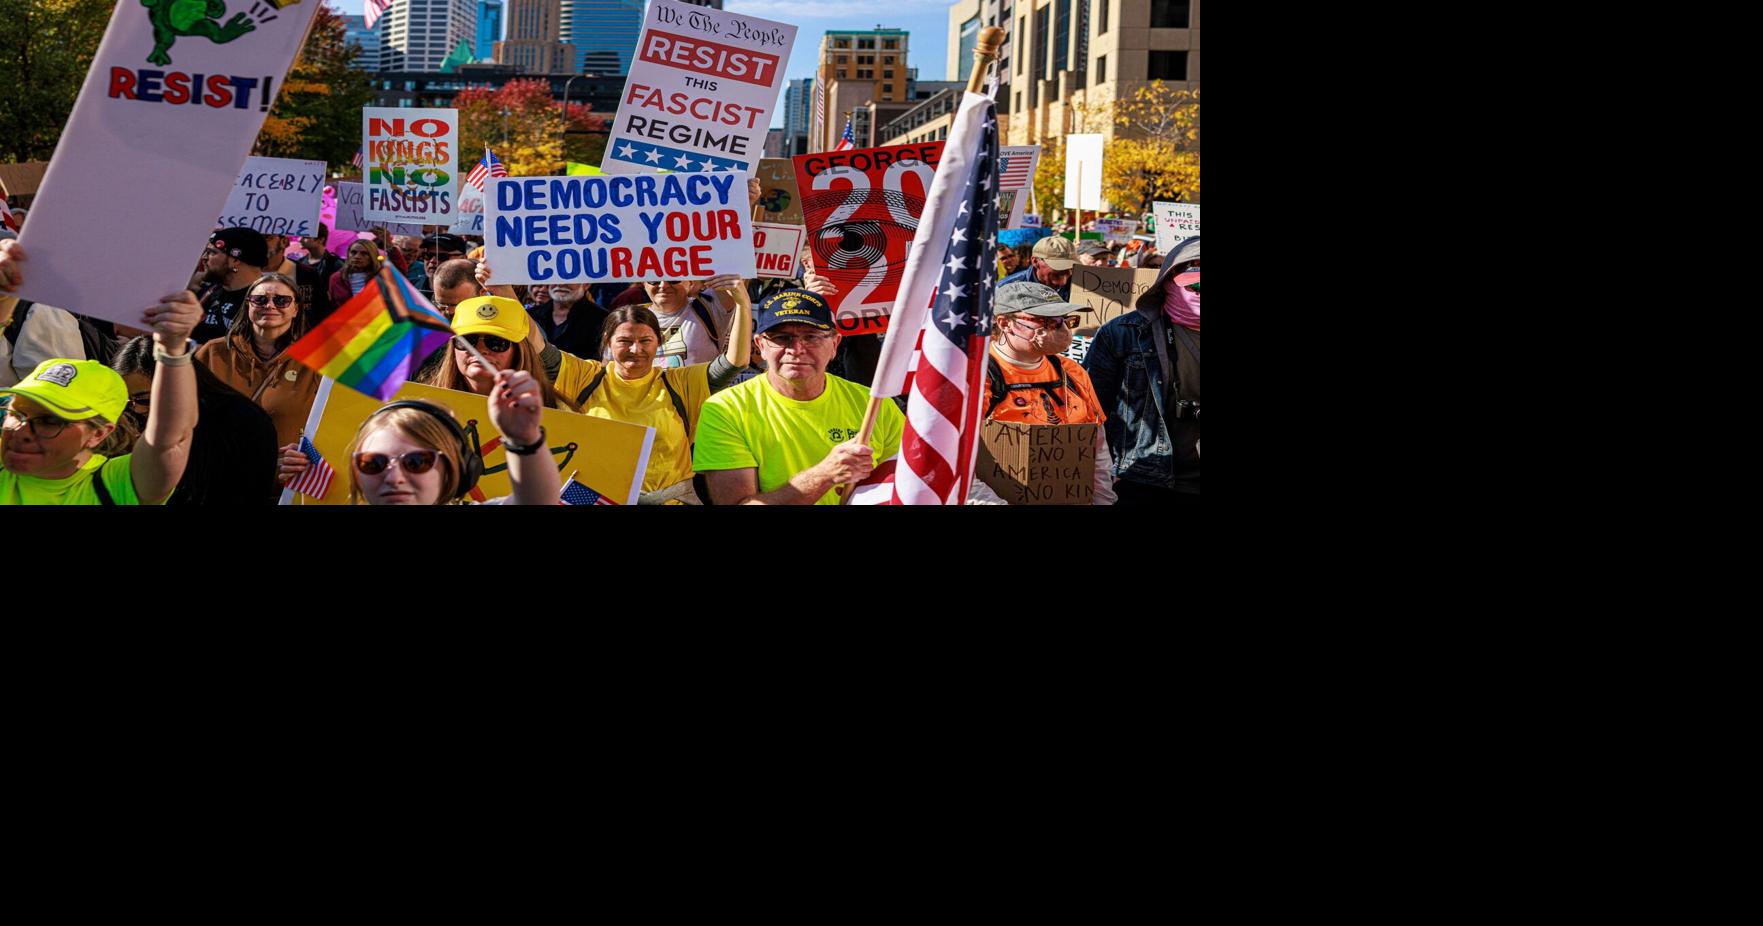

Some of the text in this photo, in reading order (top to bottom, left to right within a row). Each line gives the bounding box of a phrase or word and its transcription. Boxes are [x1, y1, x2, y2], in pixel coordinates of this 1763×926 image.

[656, 5, 786, 46] We The People
[646, 36, 772, 80] RESIST
[108, 66, 273, 112] RESIST!
[684, 76, 718, 91] THIS
[626, 83, 764, 129] FASCIST
[369, 117, 450, 138] NO
[626, 115, 750, 155] REGIME
[369, 140, 450, 166] KINGS
[804, 145, 939, 178] GEORGE
[369, 166, 450, 187] NO
[245, 193, 269, 211] TO
[369, 188, 450, 214] FASCISTS
[497, 174, 734, 211] DEMOCRACY
[1168, 210, 1193, 218] THIS
[495, 209, 742, 247] NEEDS YOUR
[527, 245, 715, 281] COURAGE
[754, 252, 792, 272] ING
[773, 291, 801, 301] MARINE
[801, 294, 823, 307] CORPS
[1086, 298, 1124, 324] NO
[774, 309, 811, 317] VETERAN
[1039, 447, 1065, 463] NO
[993, 462, 1081, 481] AMERICA
[1025, 485, 1054, 502] NO
